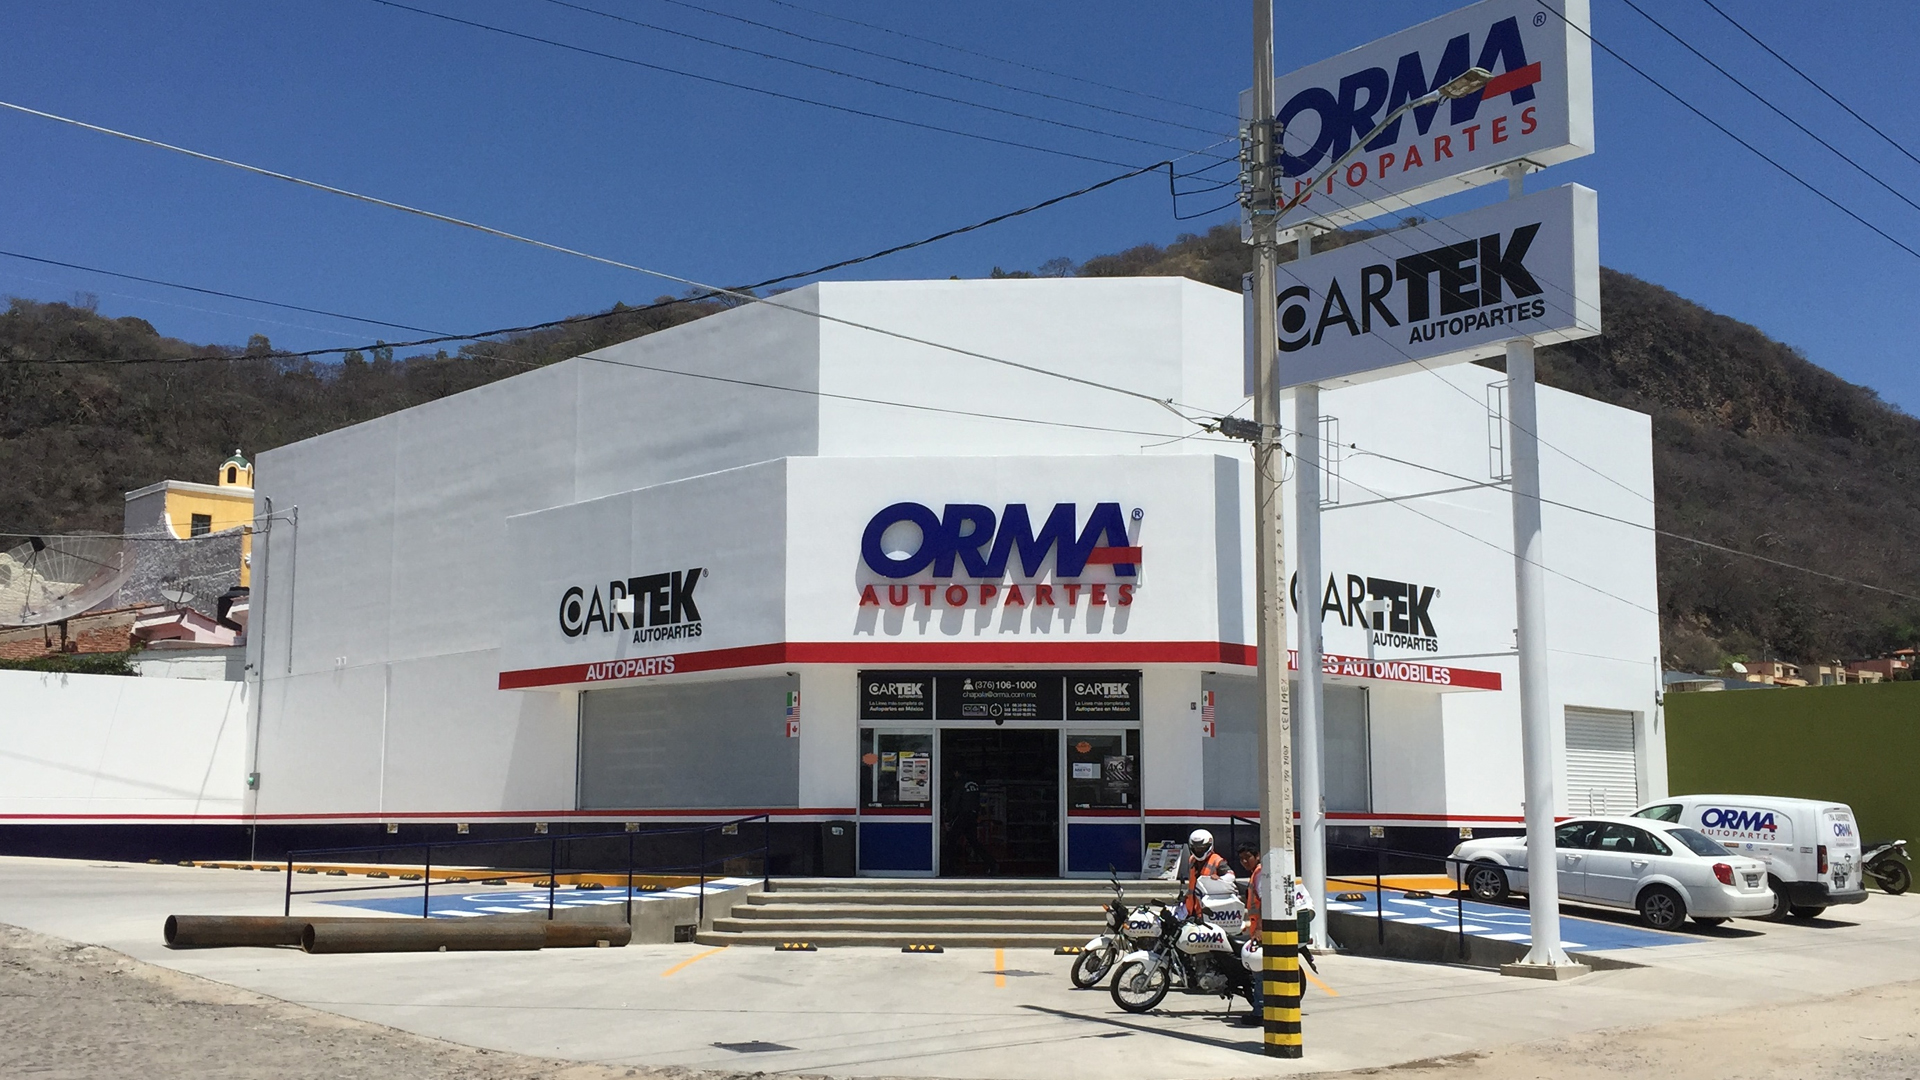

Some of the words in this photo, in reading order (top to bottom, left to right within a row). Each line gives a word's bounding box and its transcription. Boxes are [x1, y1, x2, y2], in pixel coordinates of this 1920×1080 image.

[1275, 16, 1541, 178] ORMA
[1277, 107, 1537, 208] UTOPARTES
[1277, 222, 1543, 352] CARTEK
[1409, 299, 1546, 345] AUTOPARTES
[861, 502, 1142, 578] ORMA
[560, 567, 703, 638] CARTEK
[859, 584, 1133, 606] AUTOPARTES
[633, 622, 702, 644] AUTOPARTES
[1373, 632, 1438, 653] AUTOPARTES
[586, 655, 675, 681] AUTOPARTS
[1343, 657, 1450, 685] AUTOMOBILES
[869, 683, 922, 695] CARTEK
[996, 681, 1036, 689] 106-1000
[1074, 683, 1128, 695] CARTEK
[1701, 808, 1777, 833] ORMA
[1700, 828, 1776, 841] AUTOPARTES
[1208, 910, 1242, 920] ORMA
[1187, 932, 1224, 943] ORMA
